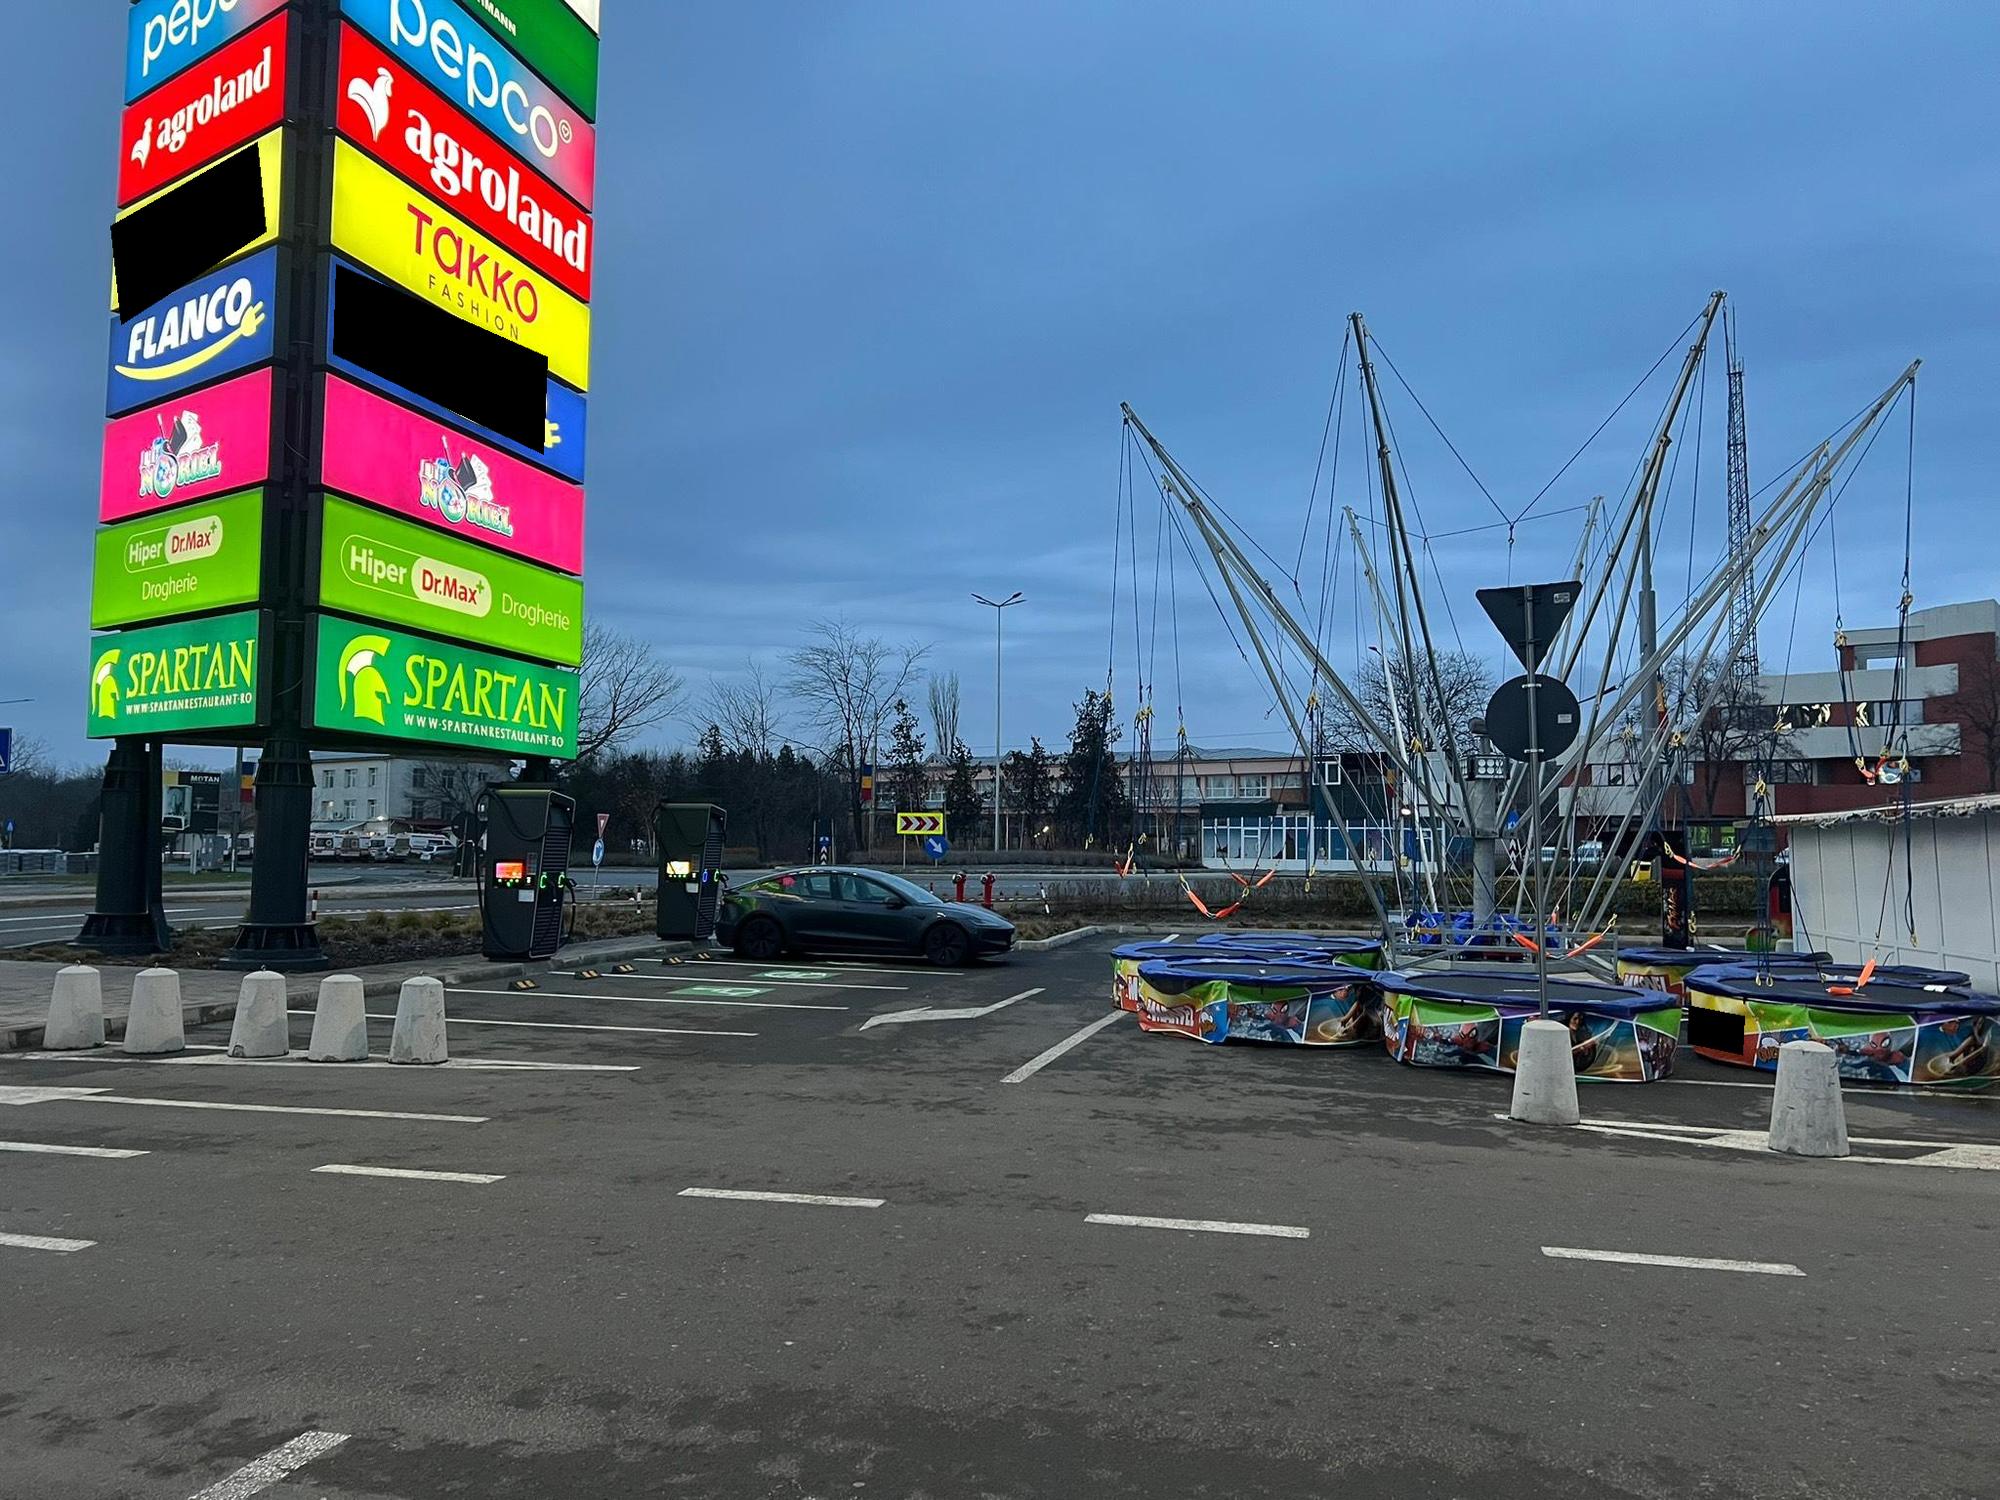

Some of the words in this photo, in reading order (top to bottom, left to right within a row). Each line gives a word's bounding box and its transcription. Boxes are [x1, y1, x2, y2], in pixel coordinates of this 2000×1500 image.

[156, 46, 272, 153] agroland
[390, 0, 559, 158] pepco
[404, 109, 587, 273] agroland
[127, 278, 252, 364] FLANCO
[428, 274, 519, 341] FASHION
[128, 540, 163, 567] Hiper
[142, 572, 198, 602] Drogherie
[350, 545, 408, 585] Hiper
[501, 593, 571, 632] Drogherie
[125, 639, 256, 699] SPARTAN
[403, 654, 568, 733] SPARTAN
[190, 775, 220, 783] MOTAN
